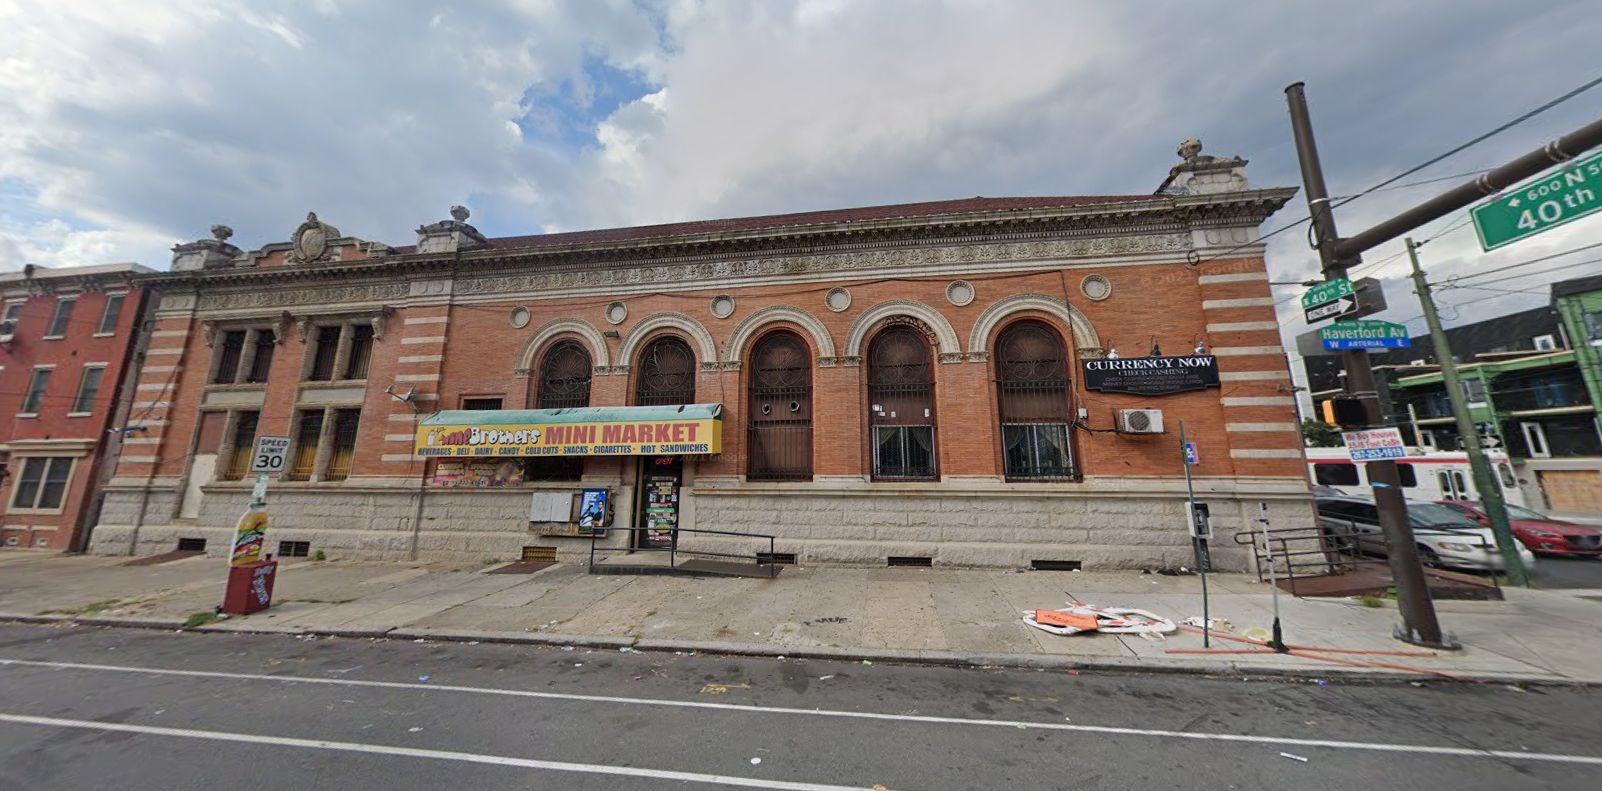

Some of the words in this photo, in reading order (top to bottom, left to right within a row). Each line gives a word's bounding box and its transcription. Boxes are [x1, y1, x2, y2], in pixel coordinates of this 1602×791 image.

[1527, 180, 1562, 200] 600
[1564, 168, 1586, 187] N
[1517, 188, 1595, 229] 40th
[1338, 281, 1354, 295] St
[1322, 327, 1385, 339] Haverford
[1390, 327, 1405, 337] Av
[1329, 340, 1339, 348] W
[1086, 358, 1174, 371] CURRENCY
[1179, 356, 1212, 367] NOW
[545, 425, 596, 444] MINI
[601, 422, 700, 444] MARKET
[261, 439, 288, 447] SPEED
[418, 447, 452, 456] BEVERAGES
[456, 447, 470, 455] DELI
[475, 447, 493, 455] DAIRY
[498, 447, 520, 455] CANDY
[525, 447, 542, 455] COLD
[542, 446, 559, 454] CUTS
[563, 446, 588, 454] SNACKS
[593, 445, 632, 454] CIGARETTES
[640, 445, 656, 453] HOT
[660, 443, 709, 453] SANDWICHES
[256, 455, 282, 468] 30
[655, 457, 673, 465] OPEN
